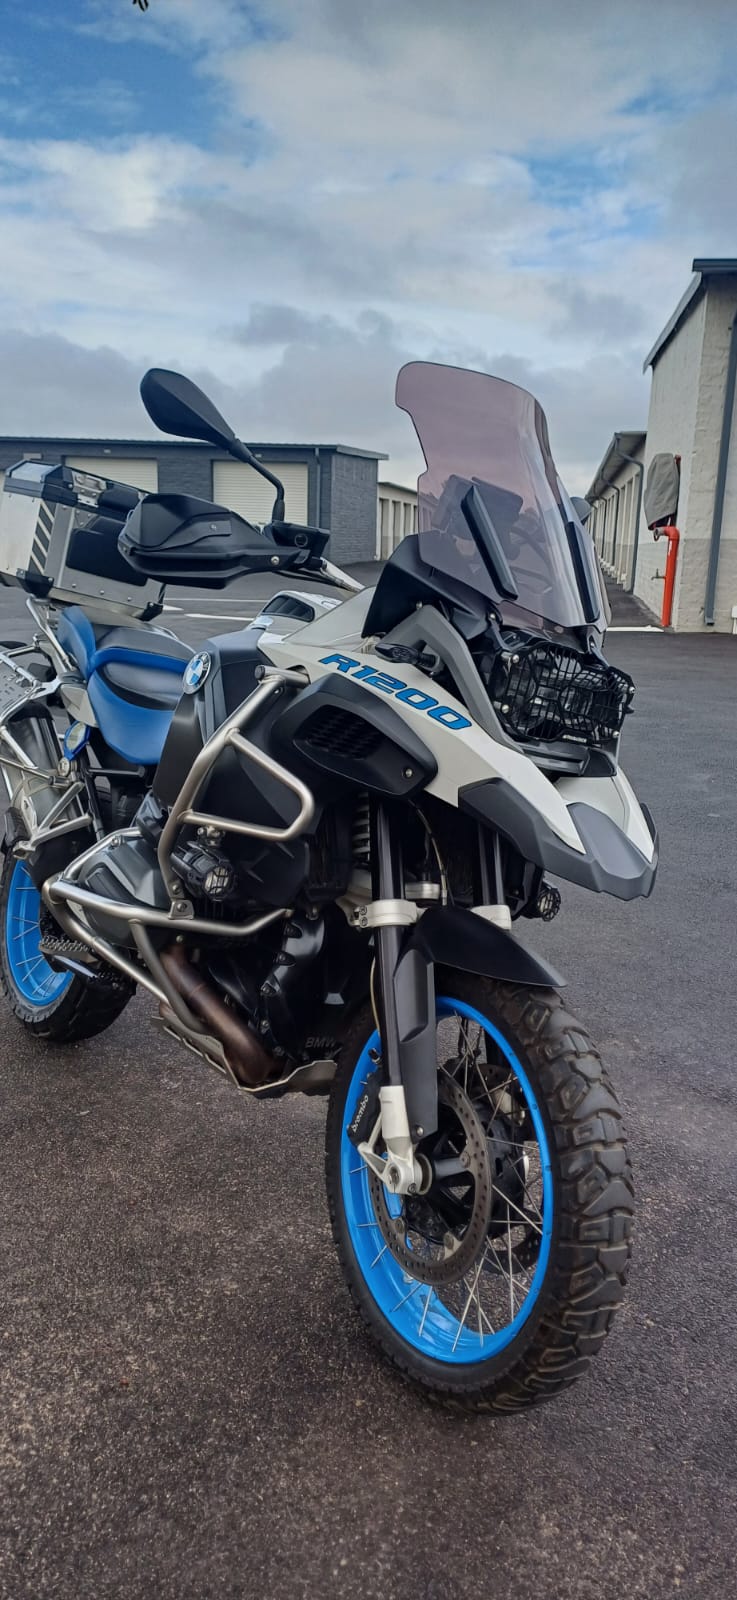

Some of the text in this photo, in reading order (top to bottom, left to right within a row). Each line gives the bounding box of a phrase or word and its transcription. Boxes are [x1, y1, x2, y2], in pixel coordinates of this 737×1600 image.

[318, 653, 472, 730] R1200
[304, 1036, 336, 1048] BMW
[351, 1095, 368, 1132] brembo
